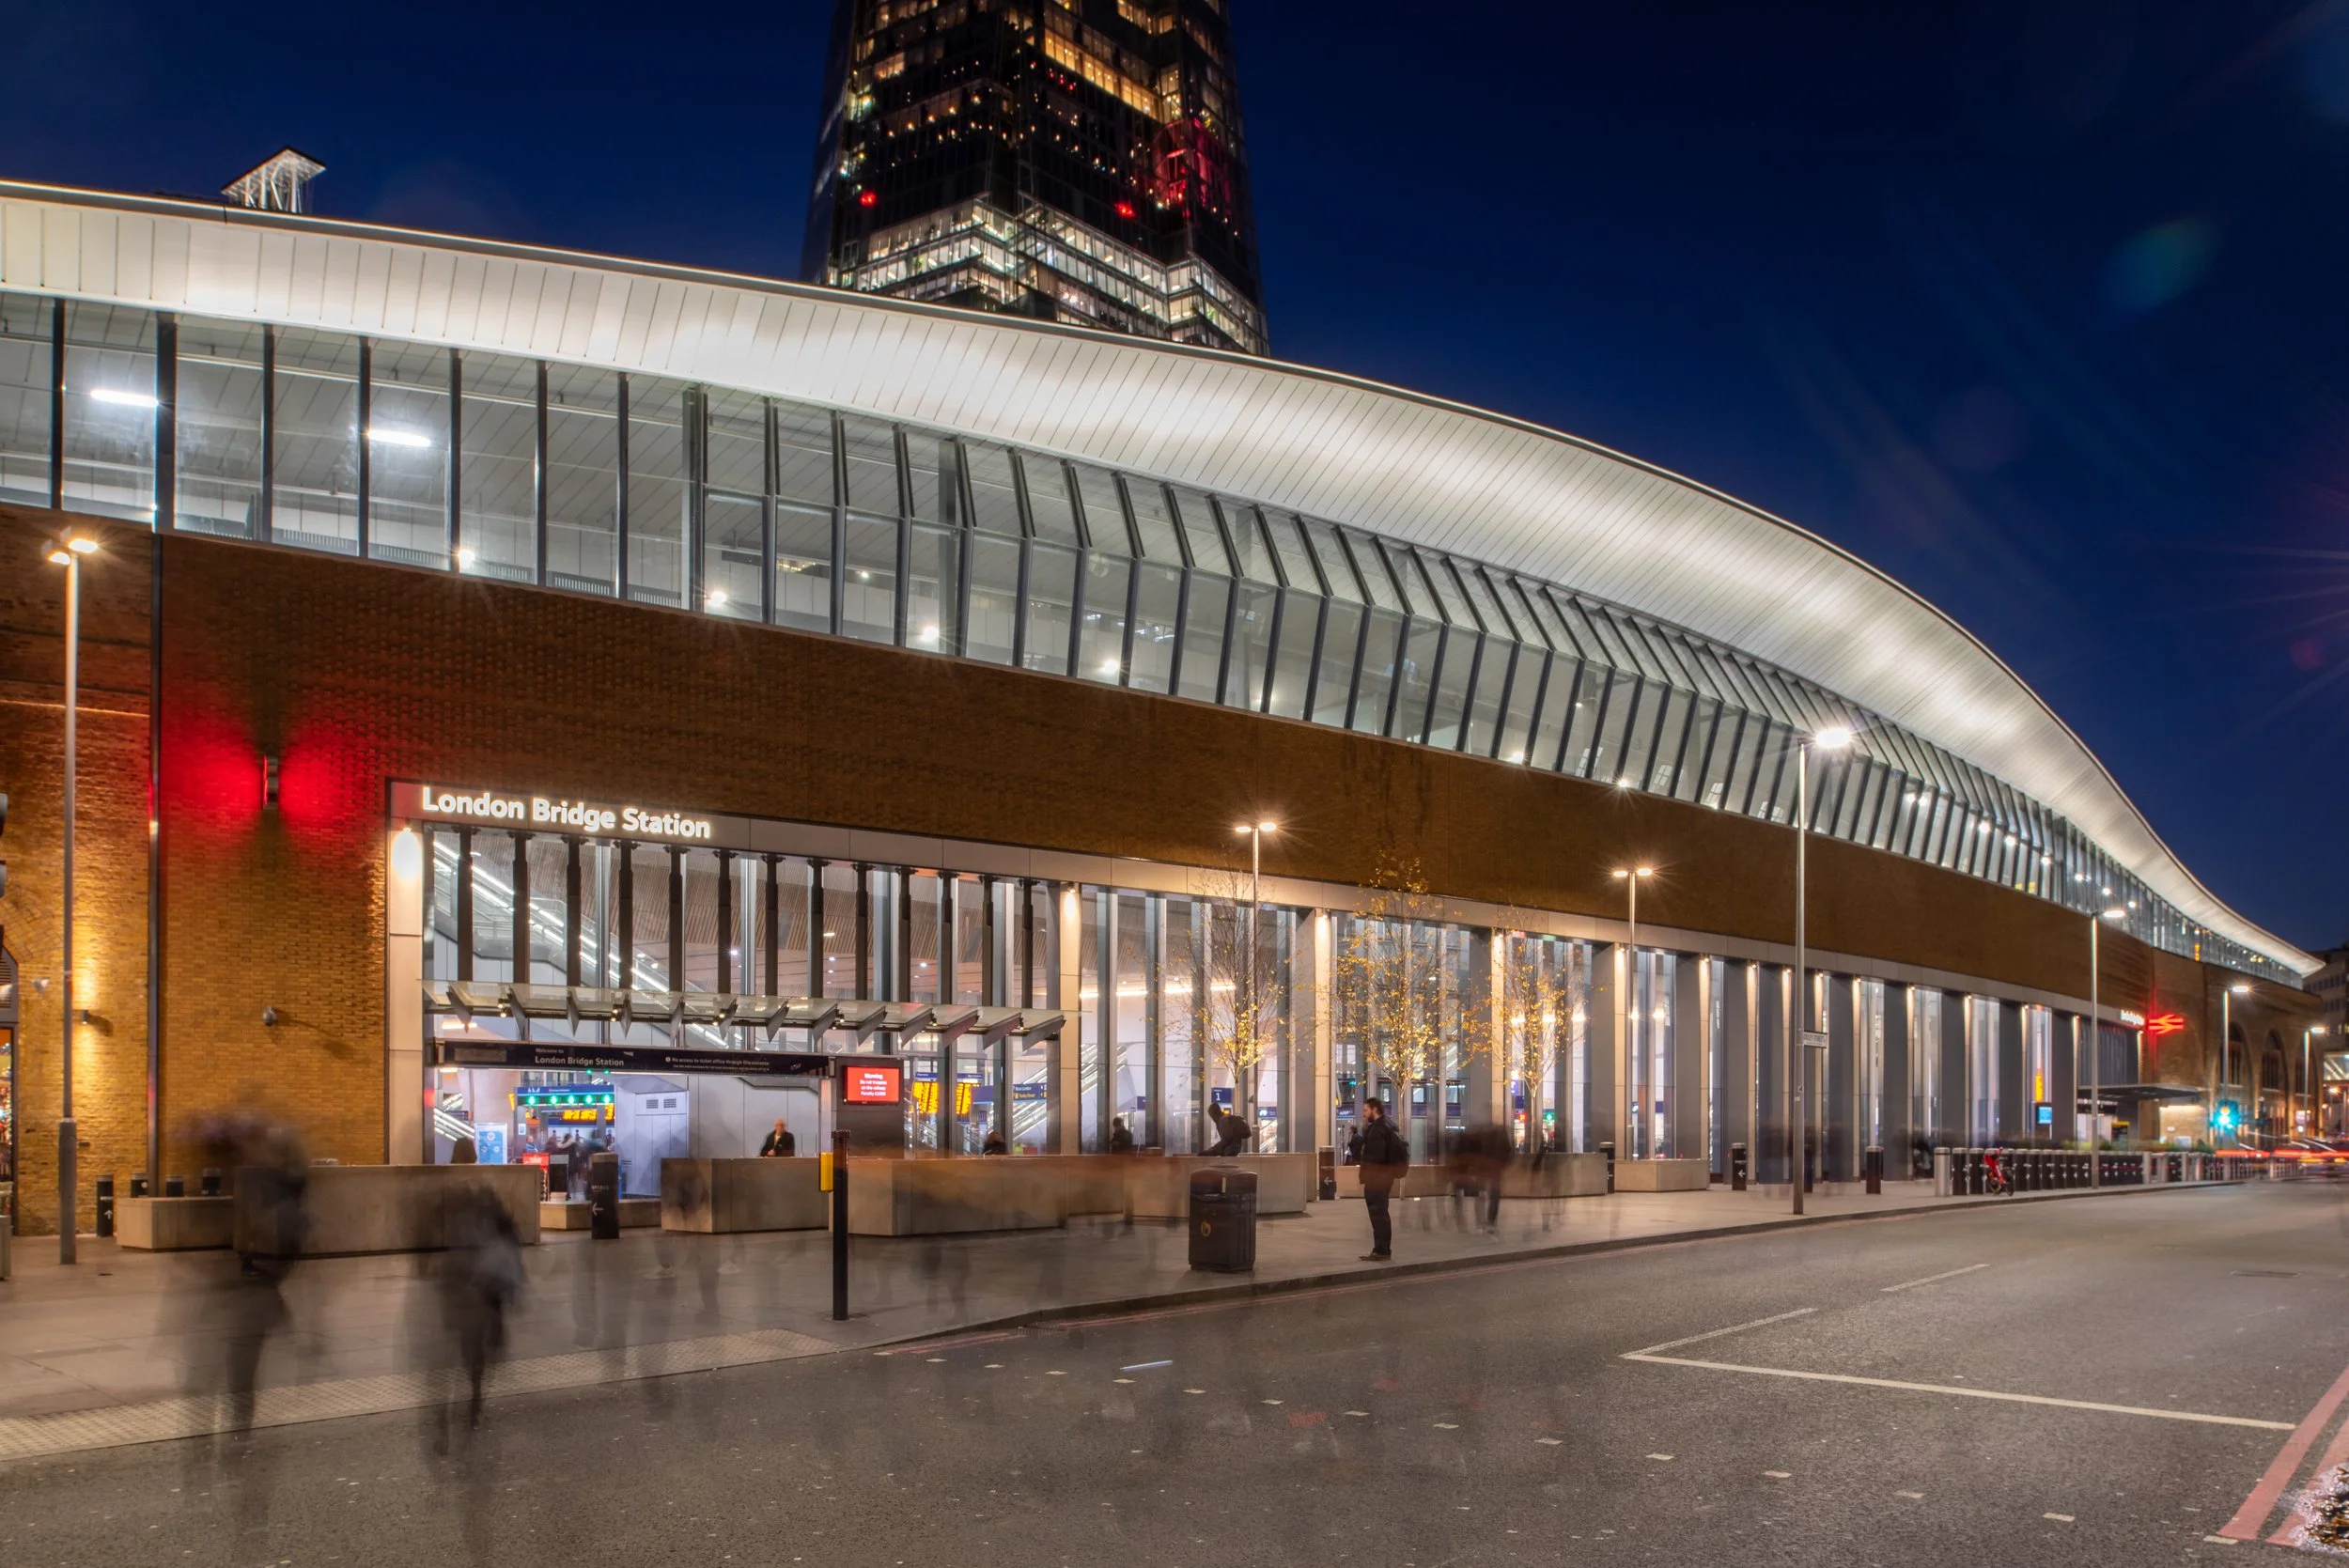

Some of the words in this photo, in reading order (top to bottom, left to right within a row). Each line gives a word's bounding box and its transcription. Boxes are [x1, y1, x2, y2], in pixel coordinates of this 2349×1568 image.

[422, 786, 524, 820] London
[532, 797, 615, 832] Bridge
[622, 807, 711, 839] Station
[535, 1056, 566, 1064] London
[568, 1057, 594, 1066] Bridge
[595, 1058, 625, 1066] Station
[1215, 1092, 1221, 1101] 1
